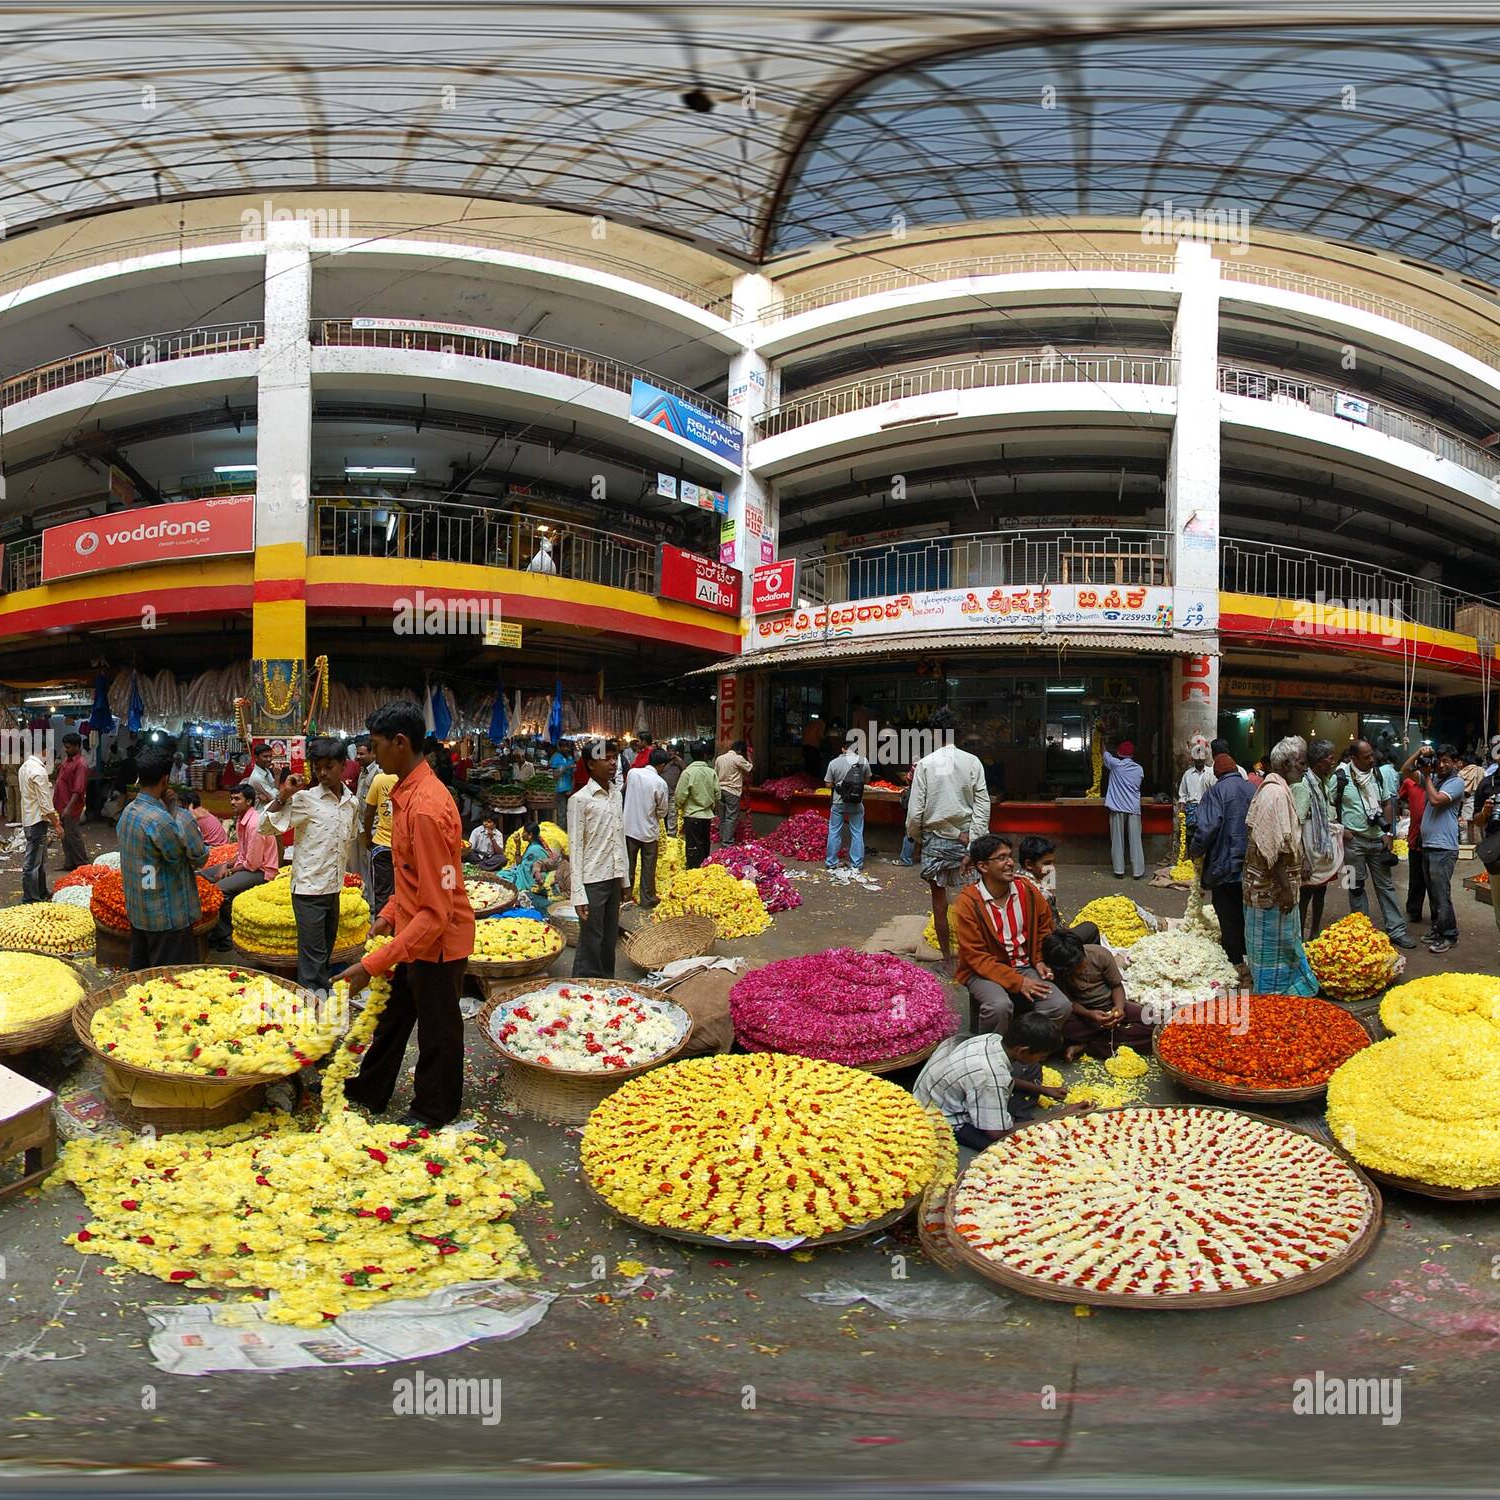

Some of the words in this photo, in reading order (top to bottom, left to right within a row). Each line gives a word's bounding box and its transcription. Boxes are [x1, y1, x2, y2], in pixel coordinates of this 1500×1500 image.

[686, 426, 718, 447] Mobile
[105, 518, 211, 546] vodafone
[698, 584, 734, 608] Airtel
[755, 591, 790, 603] vodafone
